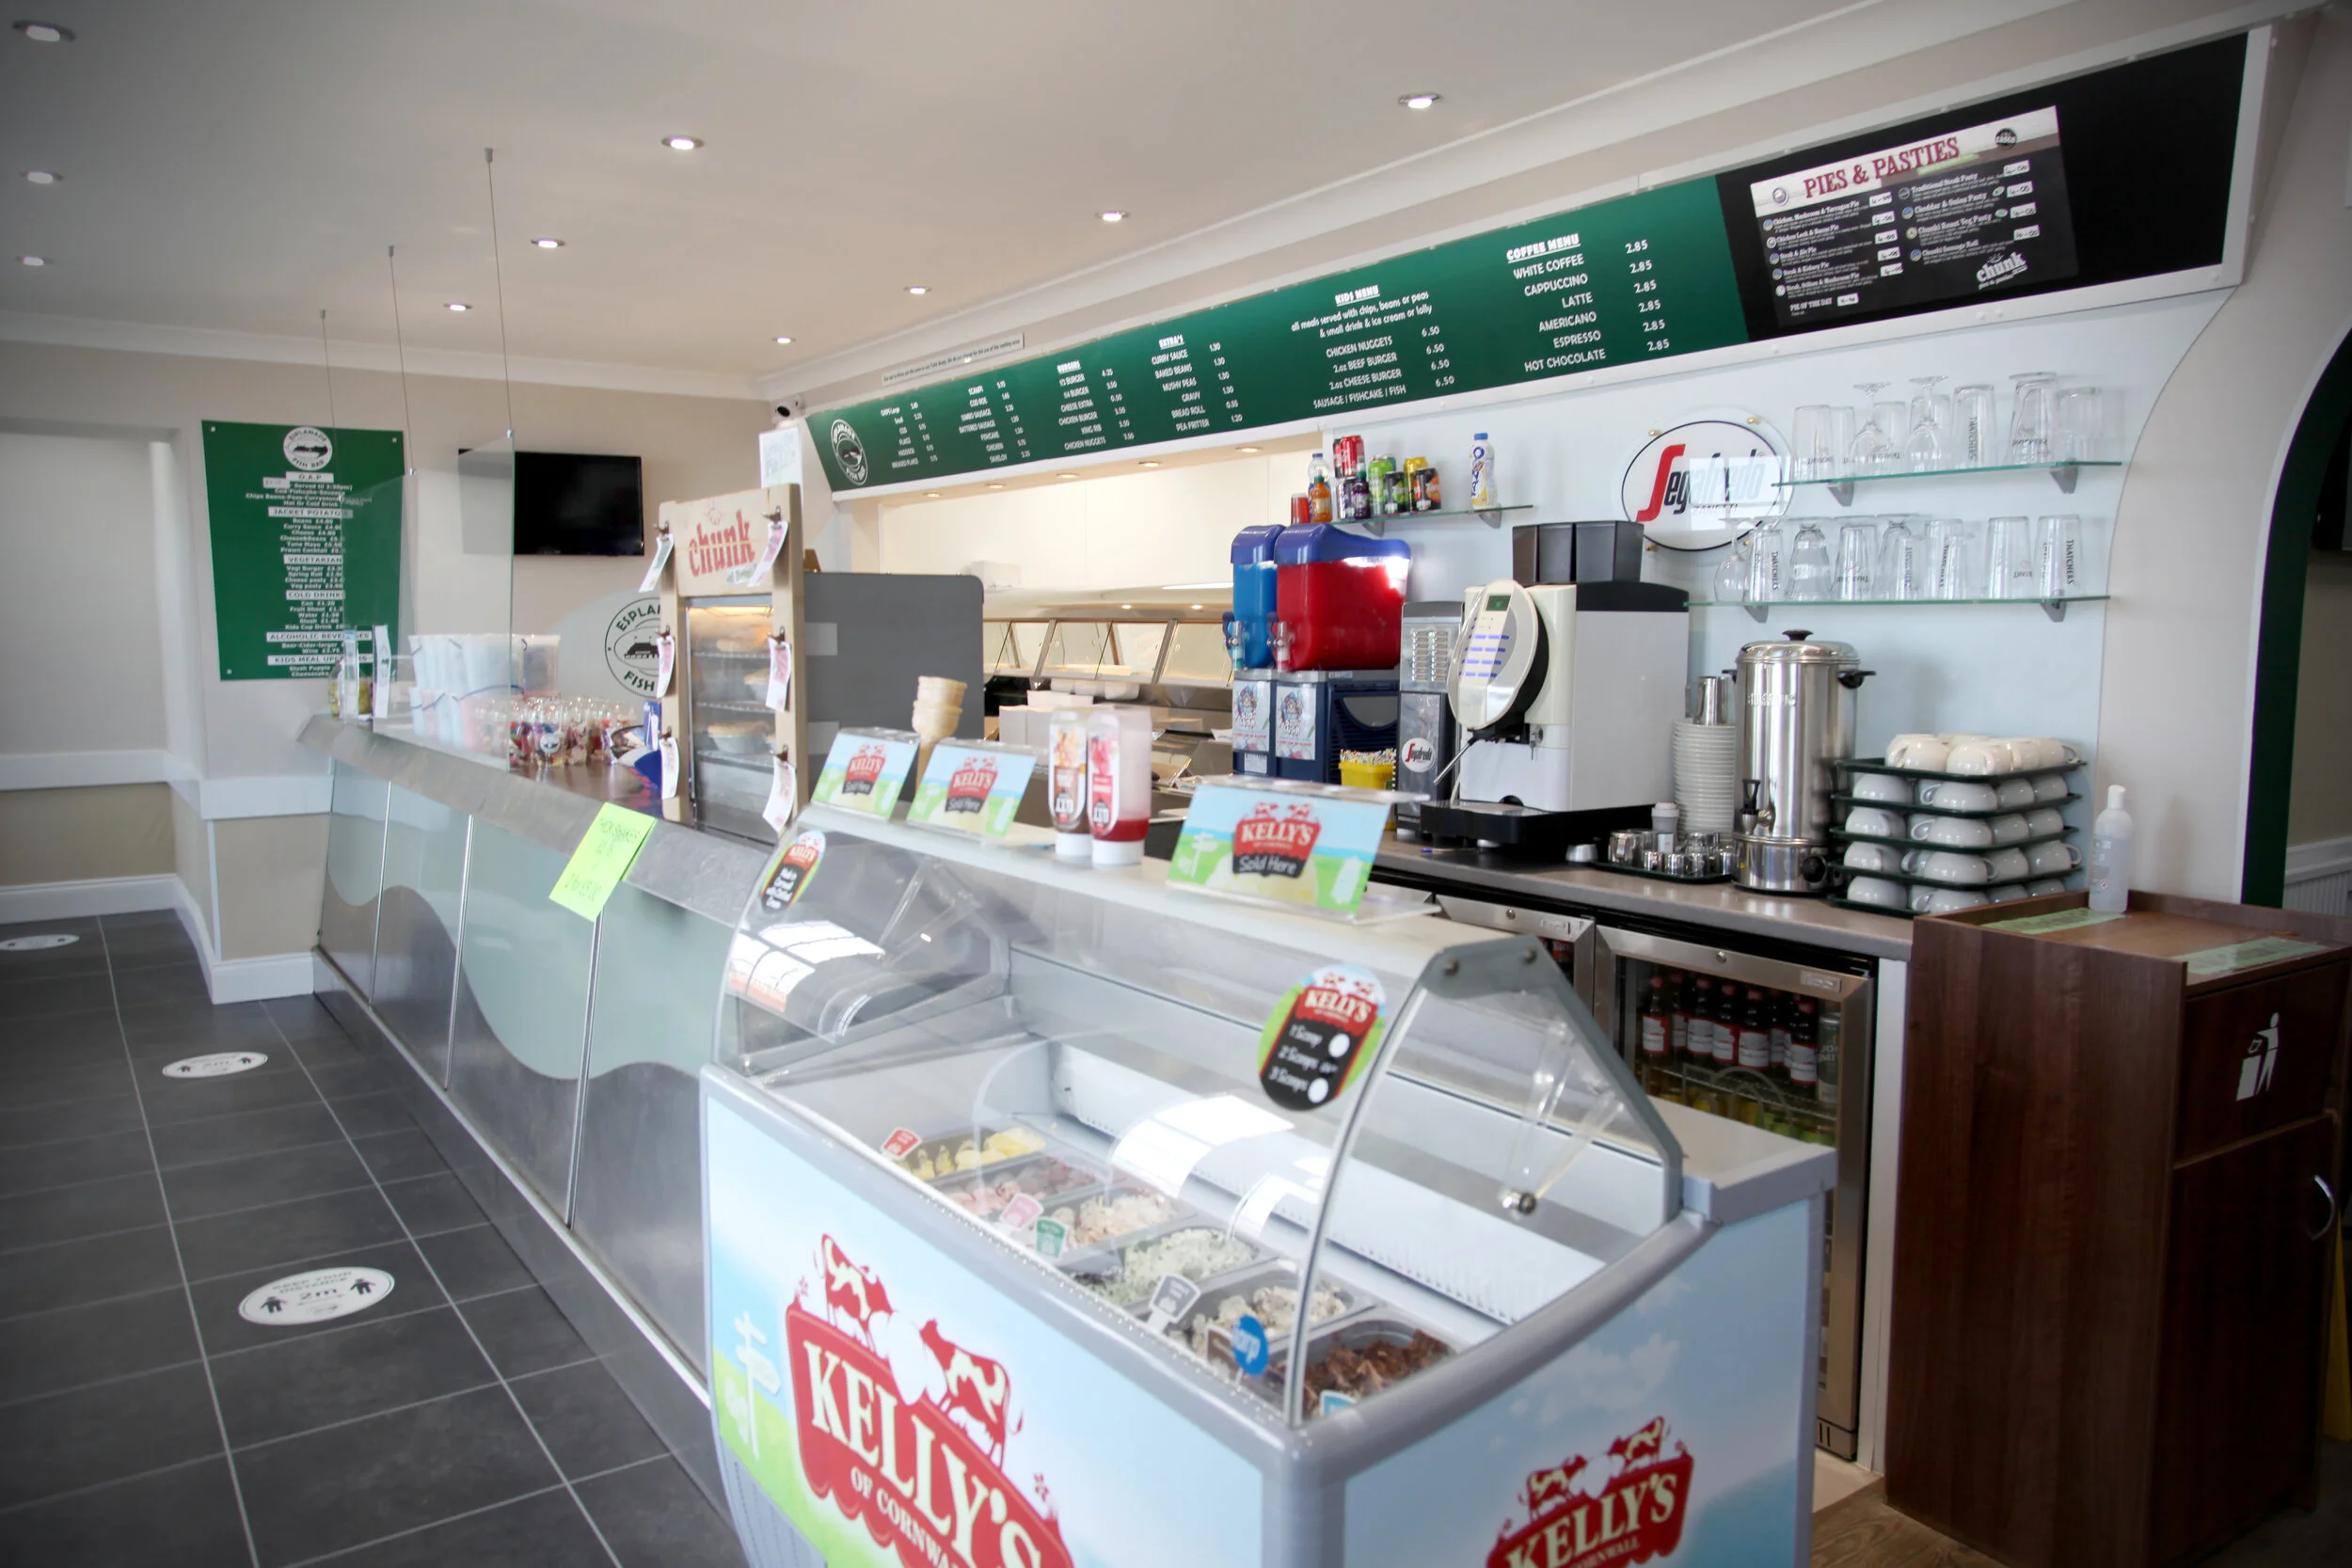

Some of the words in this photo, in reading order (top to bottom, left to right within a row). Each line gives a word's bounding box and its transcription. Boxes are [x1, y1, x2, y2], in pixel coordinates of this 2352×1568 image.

[1804, 169, 1848, 198] PIES
[1853, 164, 1869, 185] &
[1873, 136, 1961, 180] PASTIES
[1507, 243, 1546, 261] COFFEE
[1549, 233, 1580, 251] MENU
[1626, 240, 1648, 254] 2.85
[1514, 263, 1544, 279] WHITE
[1546, 253, 1584, 272] COFFEE
[1629, 260, 1652, 274] 2.85
[1977, 251, 2027, 282] chunk
[1335, 290, 1355, 304] KIDS
[1357, 285, 1379, 299] MENU
[1524, 274, 1588, 296] CAPPUCCINO
[1634, 279, 1657, 293] 2.85
[1301, 317, 1319, 328] meals
[1320, 311, 1342, 325] served
[1343, 307, 1358, 320] with
[1379, 298, 1400, 311] beans
[1402, 297, 1410, 306] or
[1411, 291, 1429, 305] peas
[1562, 293, 1593, 309] LATTE
[1639, 299, 1661, 313] 2.85
[1319, 329, 1326, 338] &
[1327, 323, 1343, 337] small
[1365, 319, 1370, 327] &
[1372, 314, 1382, 326] ice
[1383, 311, 1406, 323] cream
[1407, 309, 1415, 317] or
[1416, 304, 1432, 316] lolly
[1539, 311, 1597, 332] AMERICANO
[1643, 319, 1665, 332] 2.85
[1422, 326, 1439, 337] 6.50
[1553, 330, 1601, 349] ESPRESSO
[1169, 349, 1188, 361] SAUCE
[1327, 342, 1357, 358] CHICKEN
[1358, 336, 1392, 352] NUGGETS
[1426, 343, 1444, 355] 6.50
[1647, 339, 1670, 352] 2.85
[1348, 358, 1366, 371] BEEF
[1367, 352, 1397, 367] BURGER
[1431, 359, 1450, 371] 6.50
[1524, 358, 1544, 372] HOT
[1546, 349, 1606, 369] CHOCOLATE
[1154, 367, 1173, 379] BAKED
[1174, 363, 1193, 375] BEANS
[1343, 374, 1371, 388] CHEESE
[1372, 369, 1402, 383] BURGER
[1163, 380, 1181, 391] MUSHY
[1182, 377, 1197, 388] PEAS
[1436, 375, 1454, 388] 6.50
[1182, 391, 1200, 403] GRAVY
[1313, 396, 1344, 409] SAUSAGE
[1349, 388, 1384, 403] FISHCAKE
[1390, 385, 1406, 396] FISH
[1171, 407, 1190, 419] BREAD
[1190, 404, 1205, 416] ROLL
[1176, 421, 1187, 432] PEA
[1187, 419, 1210, 429] FRITTER
[689, 509, 755, 578] chunk
[2065, 539, 2075, 586] THATCHERS
[624, 670, 656, 692] FISH
[850, 758, 882, 773] KELLY'S
[953, 773, 993, 789] KELLY'S
[1241, 821, 1313, 846] KELLY'S
[1239, 855, 1267, 873] Sold
[1269, 857, 1298, 875] Here
[1305, 990, 1371, 1022] KELLY'S
[850, 1466, 873, 1499] OF
[876, 1488, 957, 1568] CORNW
[1505, 1472, 1677, 1568] KELLY'S
